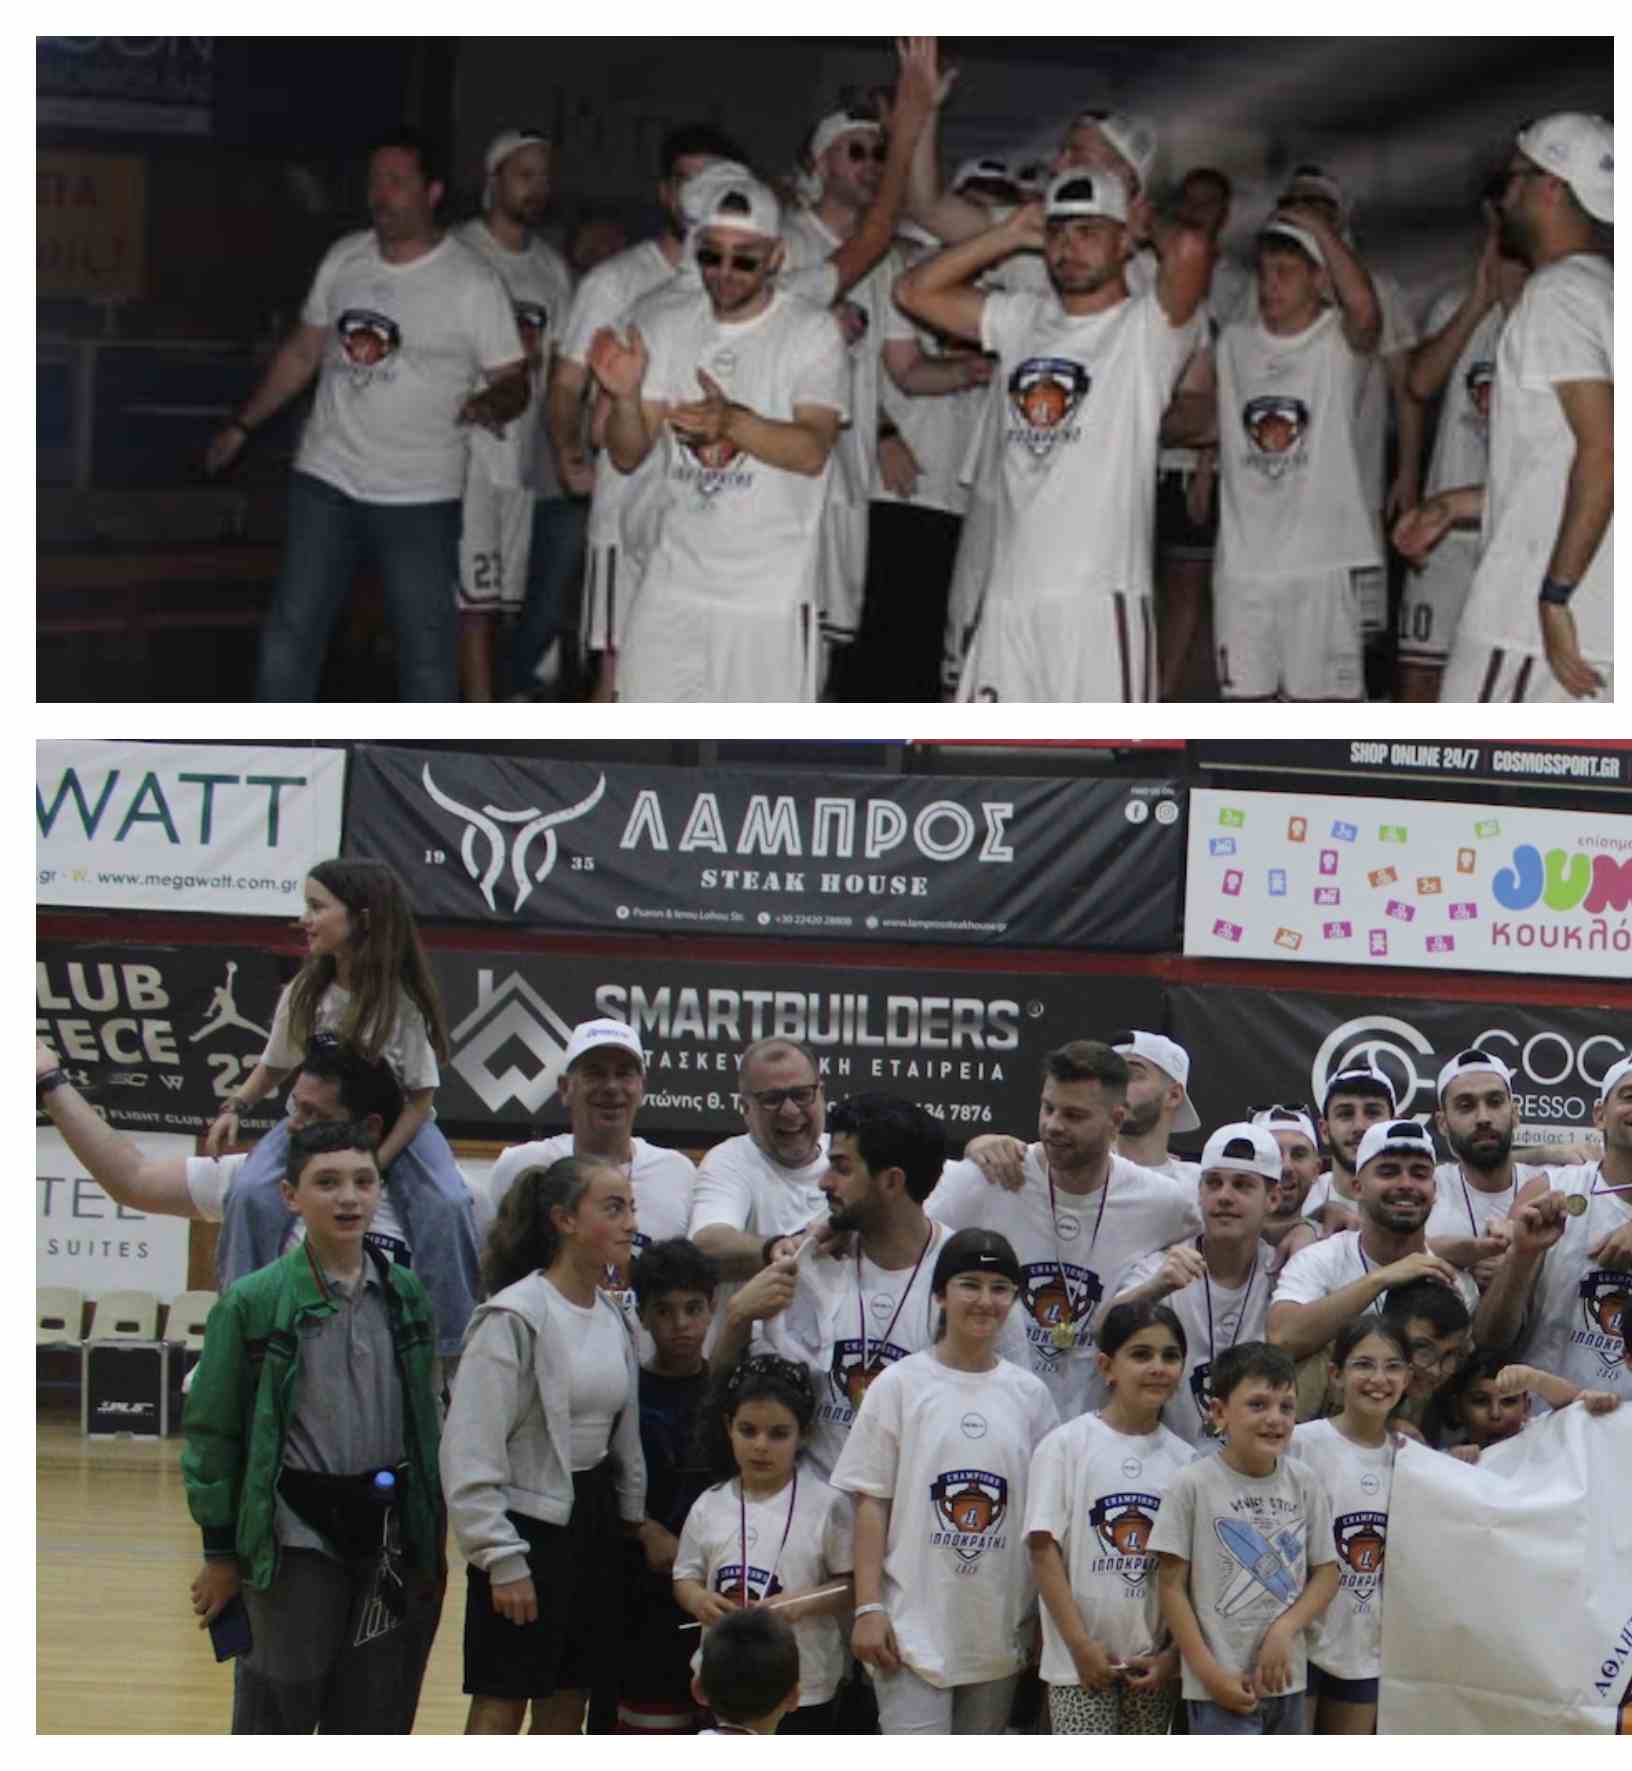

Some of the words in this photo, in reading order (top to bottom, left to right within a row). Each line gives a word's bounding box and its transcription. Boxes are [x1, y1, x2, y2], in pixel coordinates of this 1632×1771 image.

[1350, 741, 1388, 764] SHOP
[1390, 745, 1440, 768] ONLINE
[1443, 748, 1479, 771] 24/7
[1492, 750, 1620, 779] COSMOSSPORT.GR
[619, 790, 1014, 862] ΛΑΜΠΡΟΣ
[424, 849, 446, 865] 19
[571, 856, 595, 872] 35
[97, 871, 299, 892] www.megawatt.com.gr
[700, 868, 805, 892] STEAK
[820, 873, 929, 896] HOUSE
[595, 984, 1020, 1049] SMARTBUILDERS
[871, 1058, 1004, 1080] ΕΤΑΙΡΕΙΑ
[111, 1110, 160, 1123] FLIGHT
[165, 1112, 201, 1125] CLUB
[951, 1103, 993, 1121] 7876
[47, 1238, 149, 1258] SUITES
[946, 1471, 1001, 1487] CHAMPIONS
[1104, 1494, 1159, 1509] CHAMPIONS
